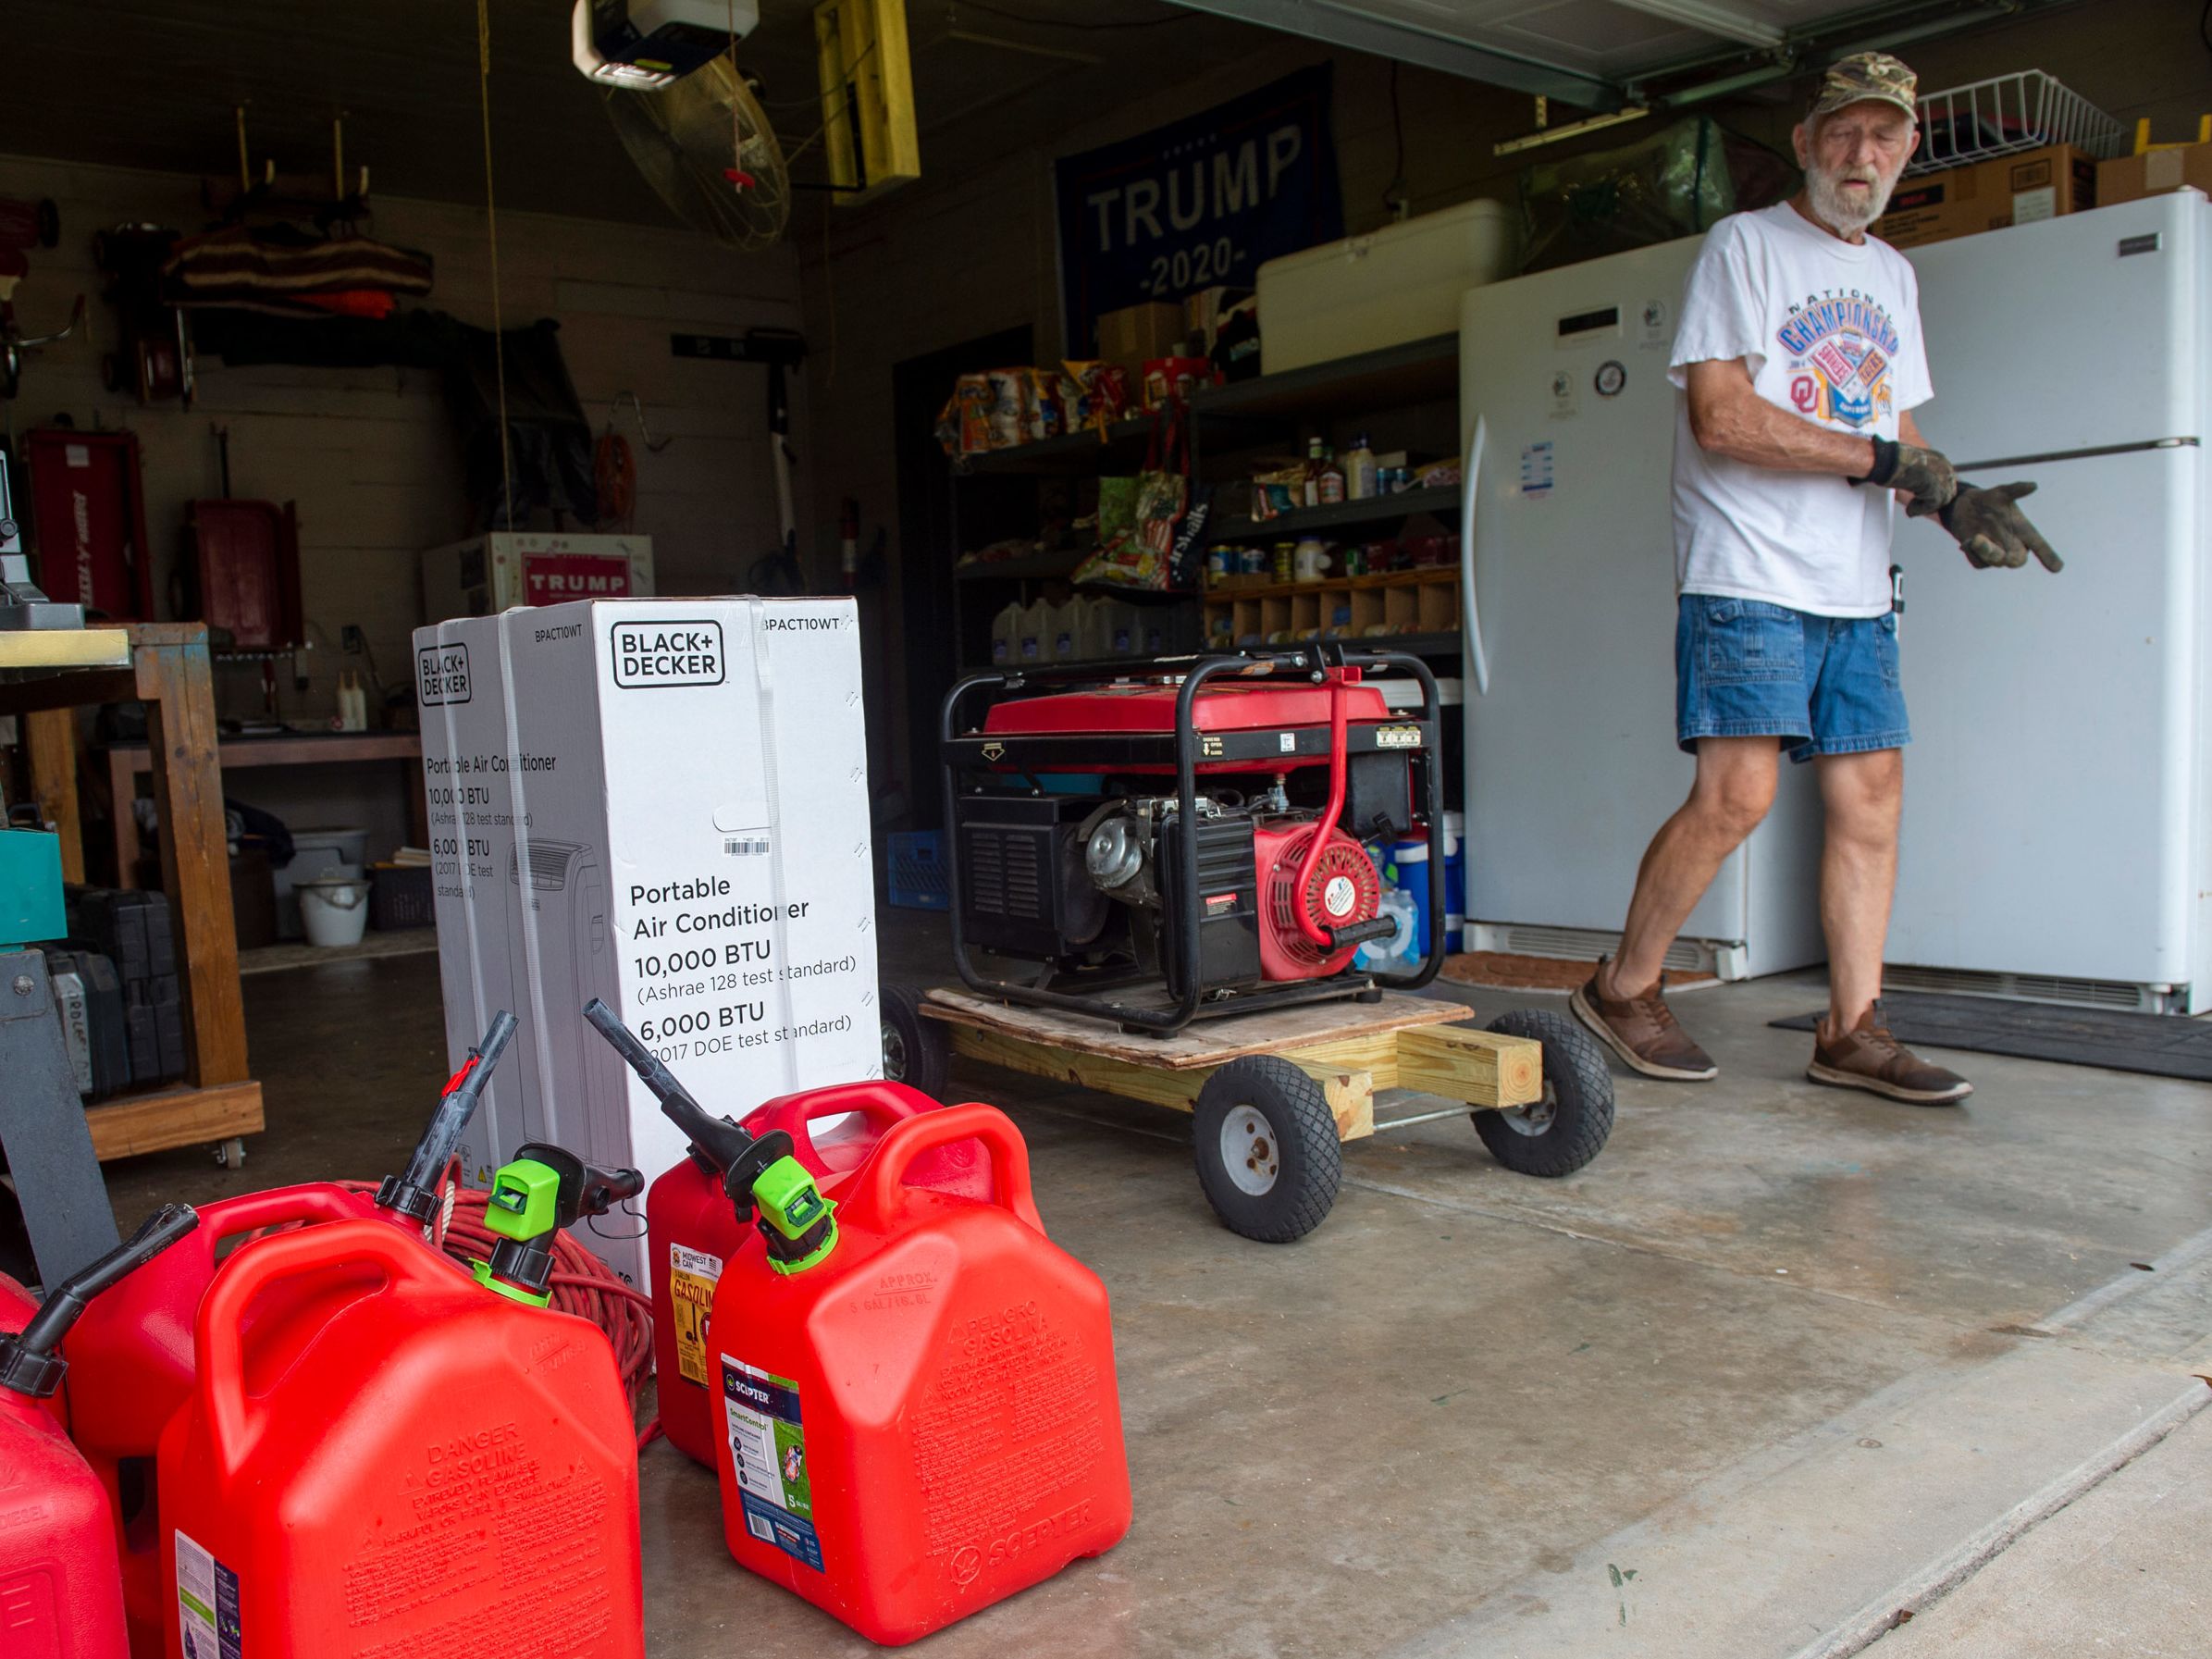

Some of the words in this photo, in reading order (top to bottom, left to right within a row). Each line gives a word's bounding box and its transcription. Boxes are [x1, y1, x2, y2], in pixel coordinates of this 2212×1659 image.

[1087, 123, 1303, 254] TRUMP
[1139, 235, 1247, 297] -2020-
[1788, 288, 1893, 324] NATIONAL
[530, 575, 624, 591] TRUMP
[535, 624, 583, 643] BPACT10WT
[622, 633, 713, 653] BLACK+
[422, 654, 464, 676] BLACK+
[624, 655, 716, 676] DECKER
[426, 756, 470, 774] Portle
[473, 755, 488, 773] Air
[491, 751, 557, 773] Coitioner
[467, 786, 489, 805] BTU
[430, 812, 456, 826] (Ashra
[477, 813, 493, 825] test
[494, 812, 533, 828] stand)
[433, 838, 458, 857] 6,00
[467, 839, 489, 856] BTU
[477, 864, 493, 878] test
[438, 885, 476, 900] standa)
[630, 875, 731, 906] Portable
[634, 917, 667, 940] Air
[635, 948, 717, 978] 10,000
[725, 939, 771, 965] BTU
[637, 981, 705, 1006] (Ashrae
[711, 973, 737, 991] 128
[743, 968, 773, 986] test
[640, 1011, 711, 1042] 6,000
[719, 1001, 764, 1027] BTU
[695, 1035, 733, 1057] DOE
[738, 1029, 769, 1047] test
[682, 1252, 706, 1265] MIDWEST
[682, 1259, 694, 1269] CAN
[881, 1272, 938, 1289] APPROX.
[851, 1303, 858, 1313] 5
[967, 1299, 1037, 1335] PELIGRO
[961, 1313, 1047, 1356] GASOLINA
[427, 1422, 518, 1465] DANGER
[426, 1442, 525, 1488] GASOLINE
[788, 1494, 796, 1507] 5
[988, 1504, 1093, 1566] SCEPTER
